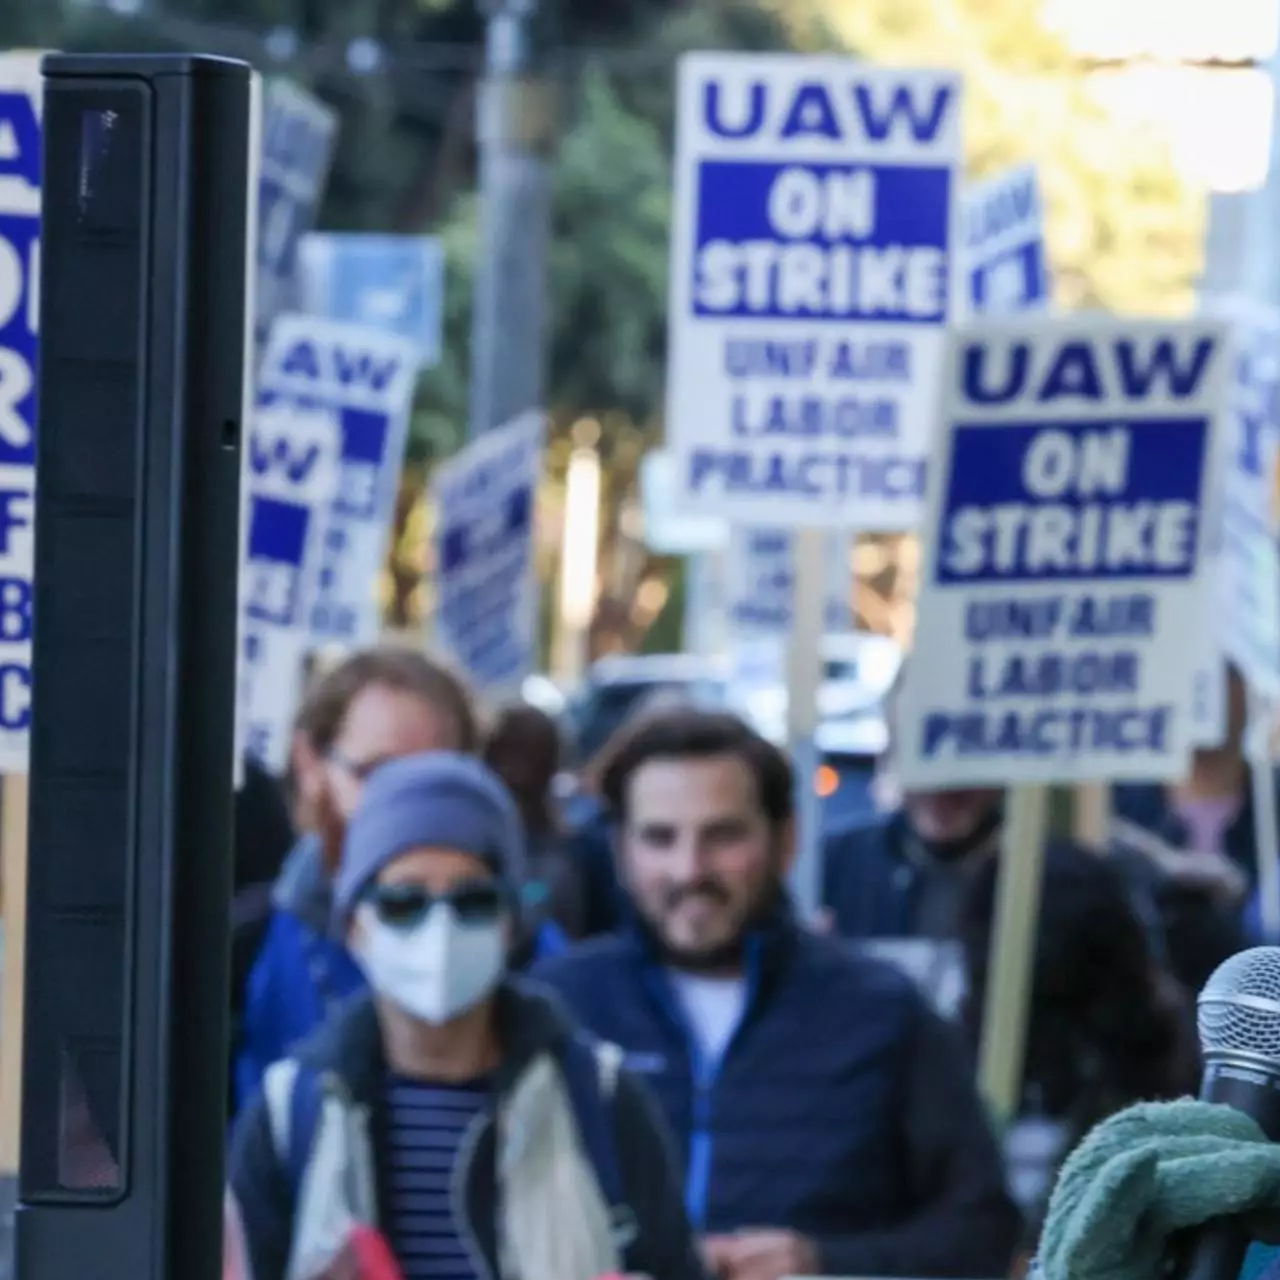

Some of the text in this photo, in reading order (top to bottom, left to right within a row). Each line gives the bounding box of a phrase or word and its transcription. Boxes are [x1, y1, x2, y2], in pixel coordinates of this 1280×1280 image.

[703, 81, 952, 143] UAW
[767, 169, 876, 240] ON
[696, 242, 944, 315] STRIKE
[725, 337, 912, 382] UNFAIR
[961, 334, 1214, 402] UAW
[733, 398, 898, 440] LABOR
[1024, 428, 1130, 498] ON
[945, 502, 1198, 575] STRIKE
[965, 596, 1155, 643] UNFAIR
[968, 652, 1138, 699] LABOR
[922, 707, 1171, 759] PRACTICE
